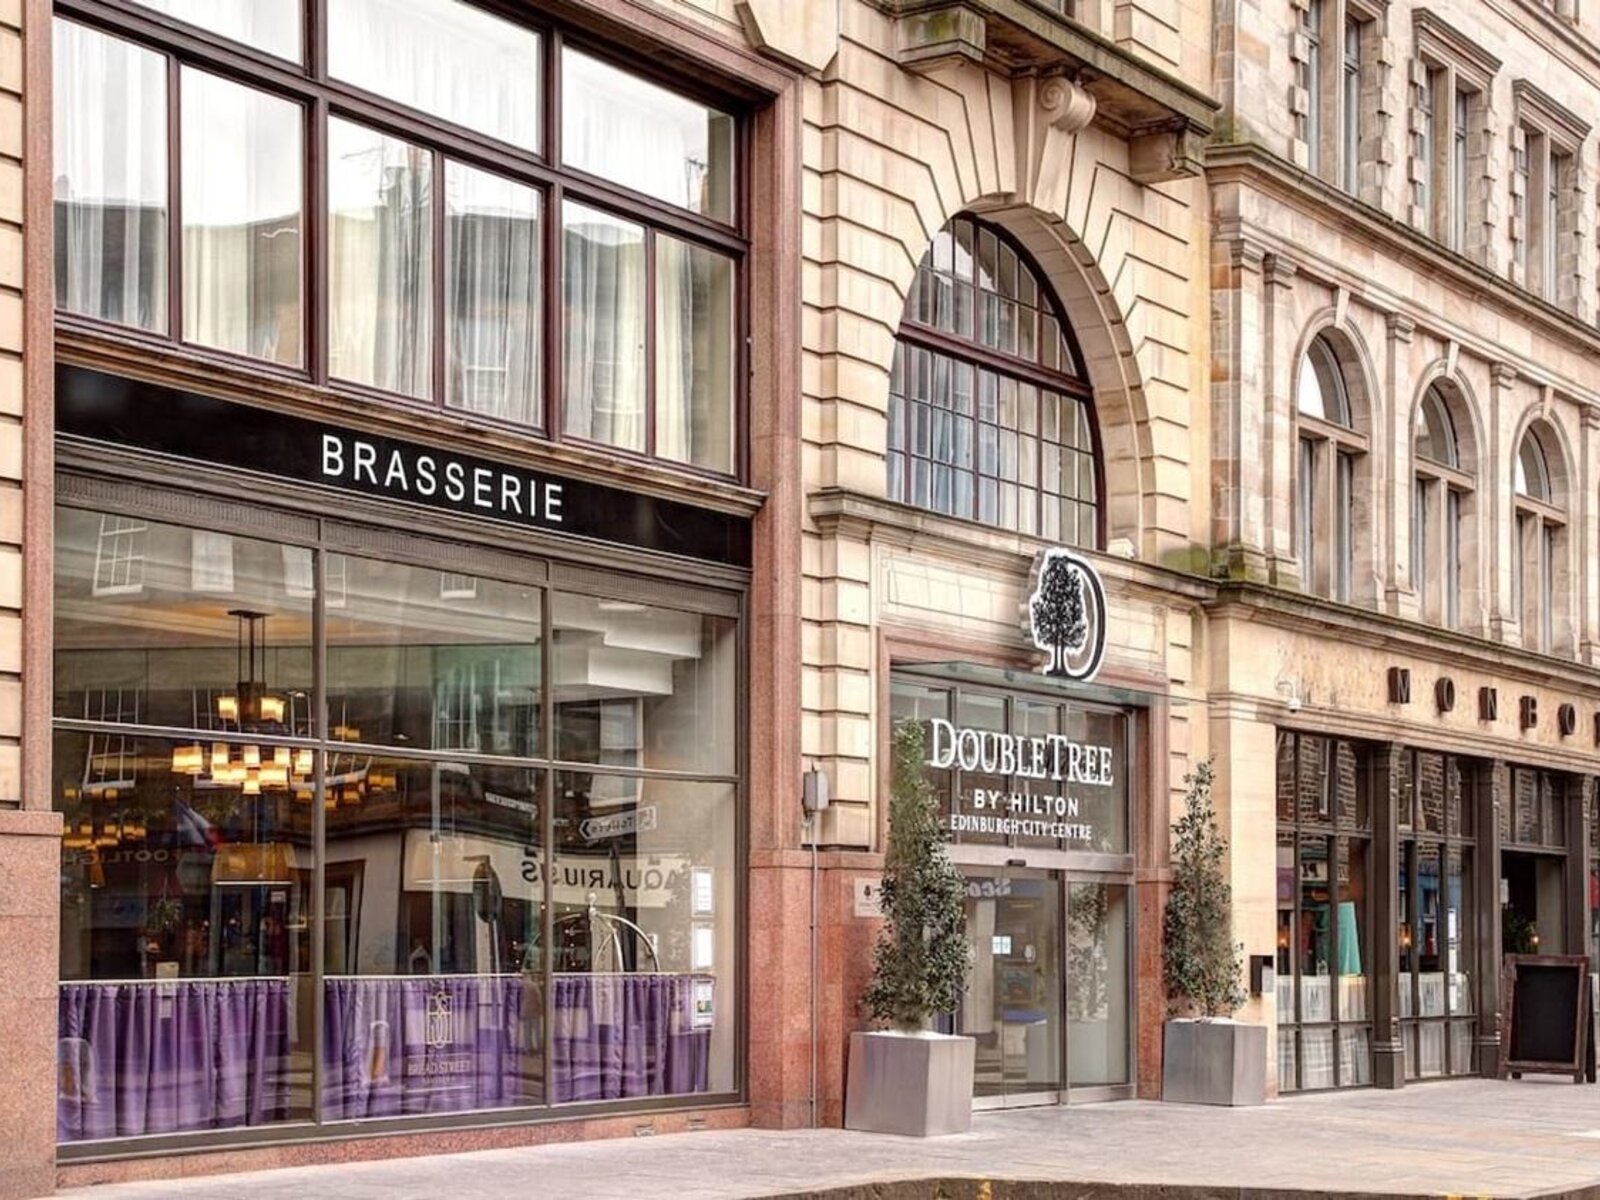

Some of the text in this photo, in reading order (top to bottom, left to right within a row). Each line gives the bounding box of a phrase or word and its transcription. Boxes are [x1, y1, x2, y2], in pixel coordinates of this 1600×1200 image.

[322, 433, 563, 522] BRASSERIE
[1386, 666, 1600, 747] MONBO
[950, 814, 1092, 841] EDINBURGH CITY CENTRE
[974, 789, 1079, 817] BY HILTON
